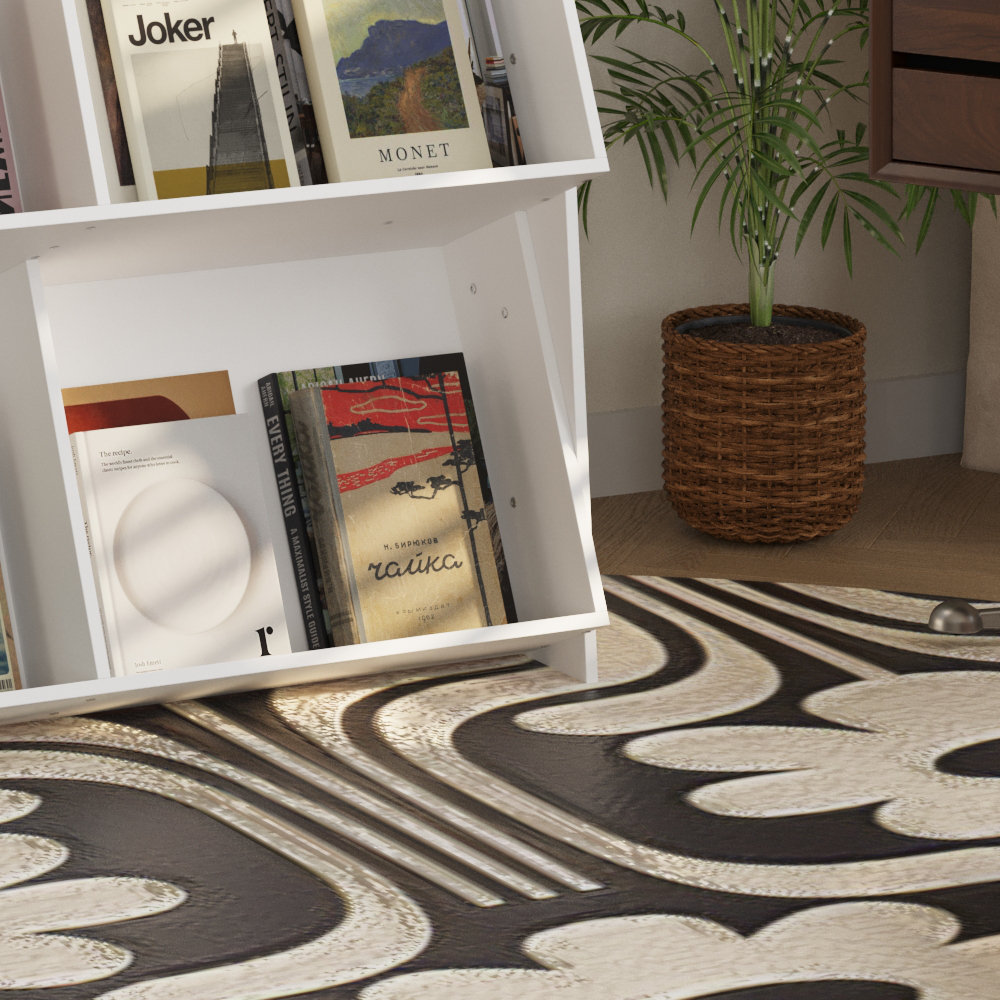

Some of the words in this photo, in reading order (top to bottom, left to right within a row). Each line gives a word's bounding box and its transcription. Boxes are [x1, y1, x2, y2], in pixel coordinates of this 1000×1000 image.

[128, 12, 215, 47] Joker
[378, 142, 450, 163] MONET
[267, 414, 286, 464] EVERY
[277, 467, 296, 518] THING
[395, 537, 439, 550] БИРЮКОВ
[291, 537, 309, 594] MAXIMALIST
[368, 552, 463, 581] чайка
[303, 593, 315, 624] STYLE
[308, 623, 320, 650] GUIDE
